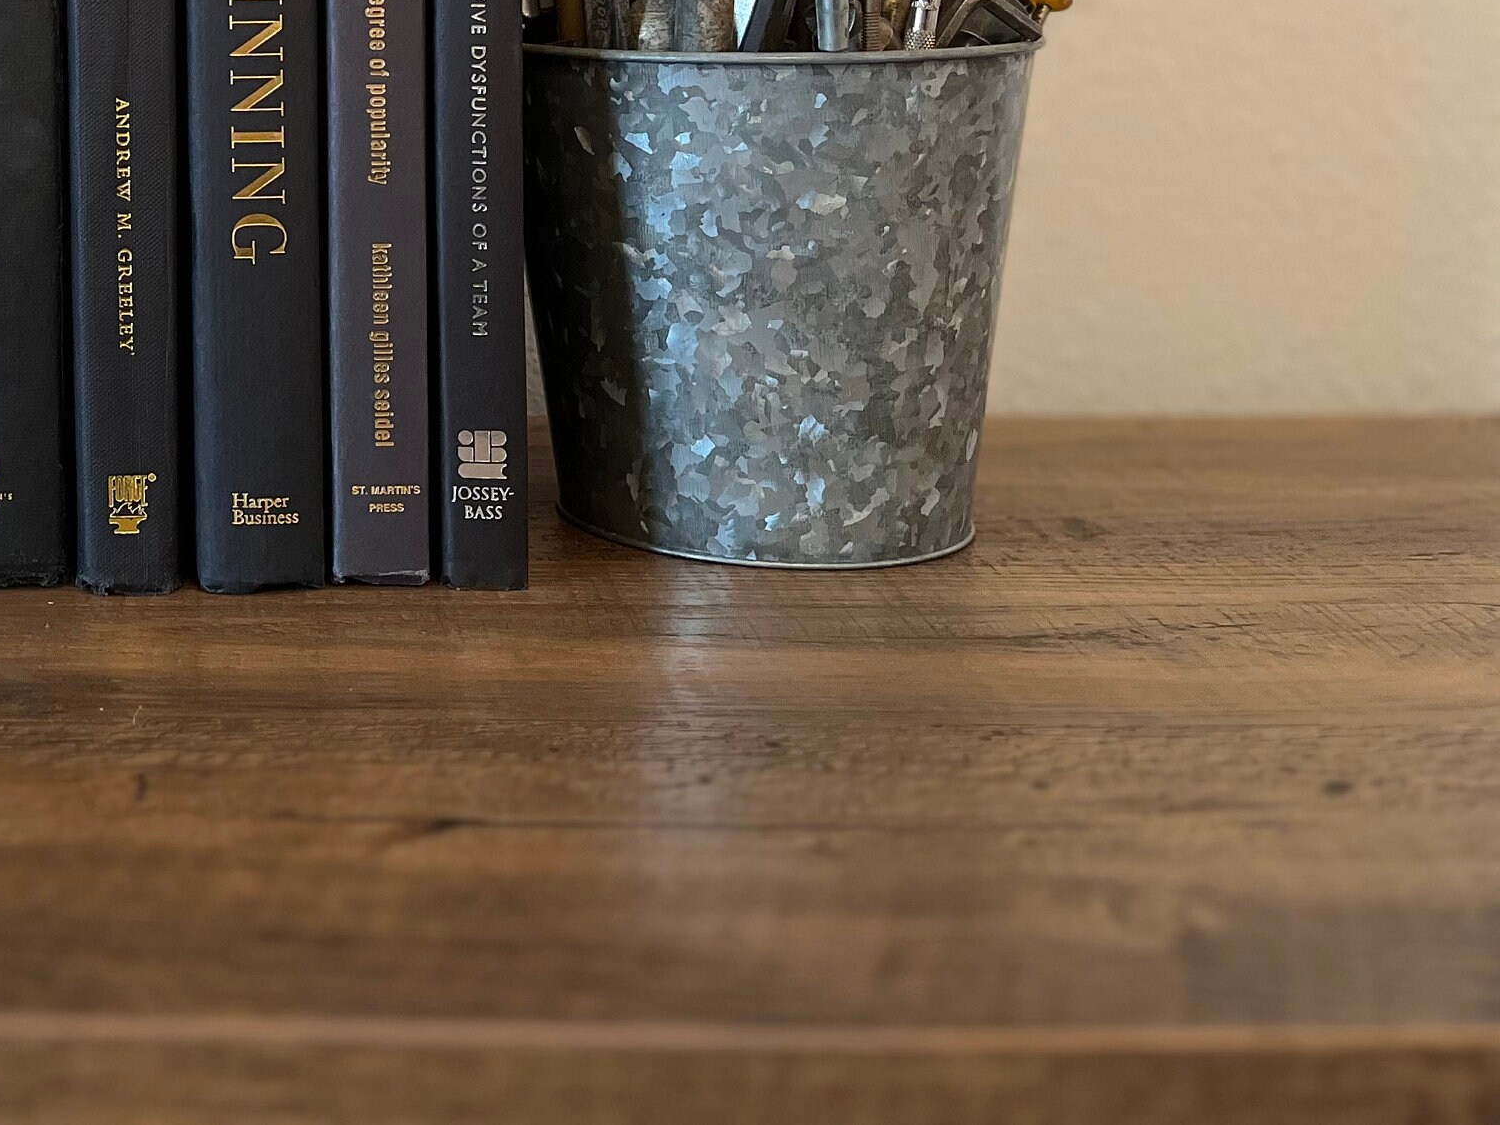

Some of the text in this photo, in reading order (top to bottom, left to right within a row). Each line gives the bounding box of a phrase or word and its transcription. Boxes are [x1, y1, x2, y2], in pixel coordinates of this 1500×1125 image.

[370, 59, 389, 76] of
[366, 84, 390, 184] popularity
[471, 46, 487, 212] DYSFUNCTIONS
[116, 98, 133, 350] ANDREW M. GREELEY
[472, 224, 487, 250] OF
[471, 258, 487, 272] A
[473, 280, 488, 335] TEAM
[369, 244, 394, 446] kathleen gilles seidel
[351, 485, 421, 495] ST. MARTIN'S
[452, 486, 514, 502] JOSSEY-
[232, 493, 289, 512] Harper
[369, 502, 405, 513] PRESS
[232, 510, 299, 525] Business
[465, 505, 502, 519] BASS
